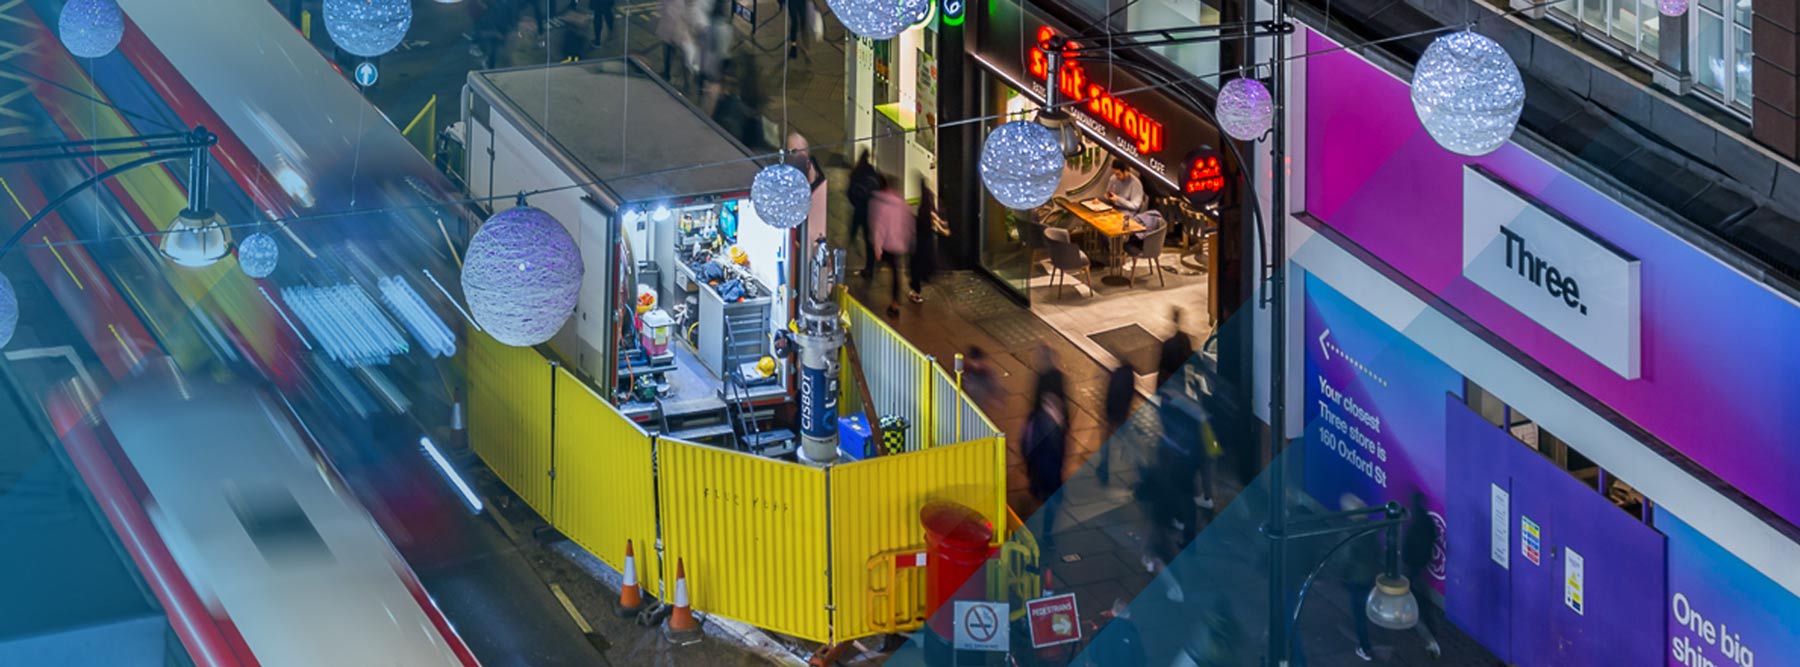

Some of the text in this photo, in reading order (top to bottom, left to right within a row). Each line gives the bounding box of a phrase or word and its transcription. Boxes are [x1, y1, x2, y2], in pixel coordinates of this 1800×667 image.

[1499, 224, 1587, 316] Three.
[801, 371, 812, 431] CISBOT
[1318, 375, 1381, 434] Your closest
[1318, 400, 1387, 463] Three store is
[1318, 426, 1387, 488] 160 Oxford St
[1031, 602, 1073, 617] PEDESTRIANS
[1672, 592, 1754, 667] One big
